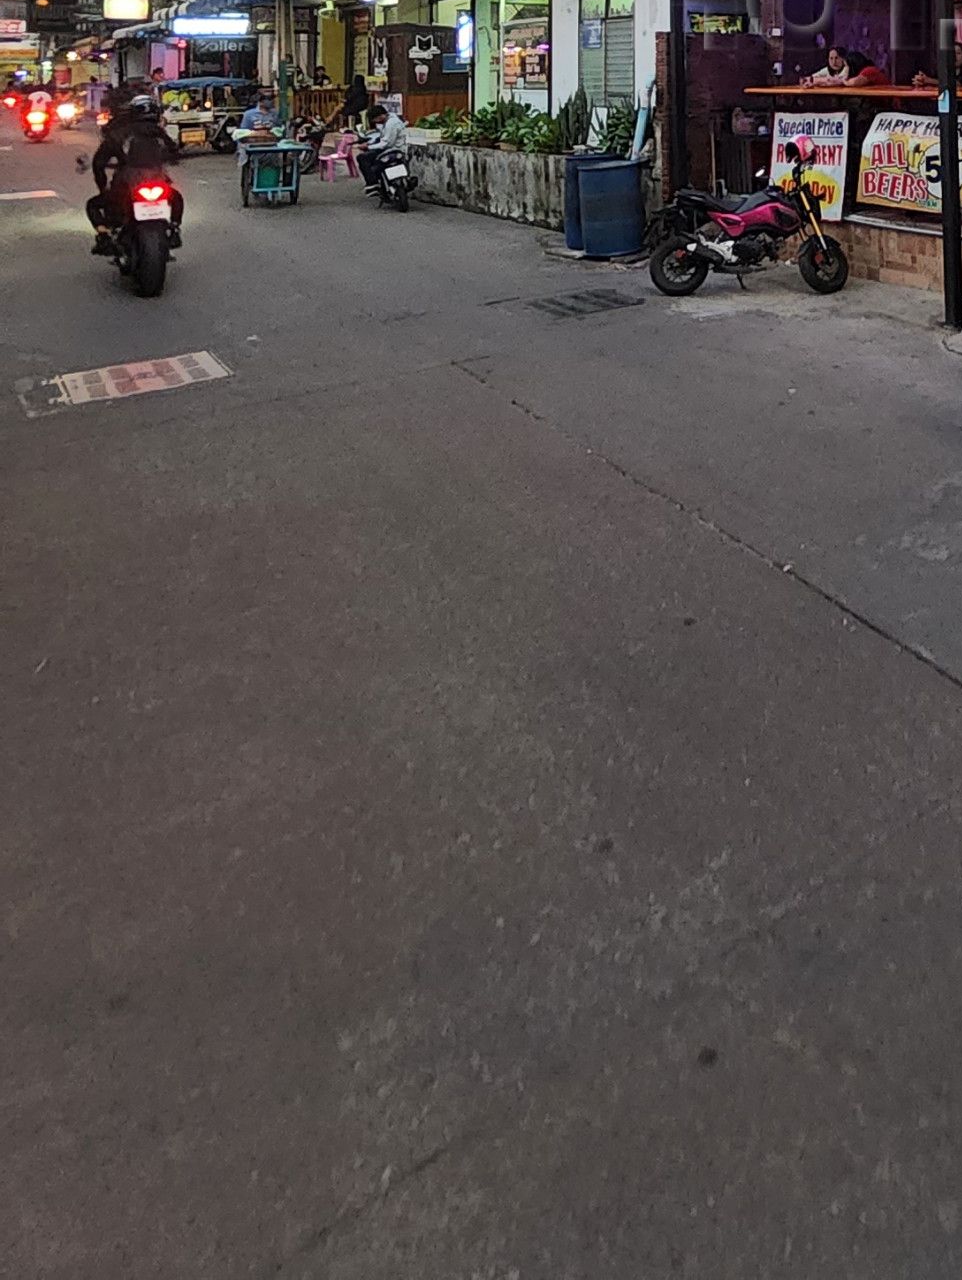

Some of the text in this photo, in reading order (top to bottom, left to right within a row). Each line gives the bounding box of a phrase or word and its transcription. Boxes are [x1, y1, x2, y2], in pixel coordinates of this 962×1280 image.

[778, 118, 844, 136] Special Price
[876, 118, 922, 135] HAPPY
[870, 140, 908, 169] ALL
[863, 171, 929, 201] BEERS
